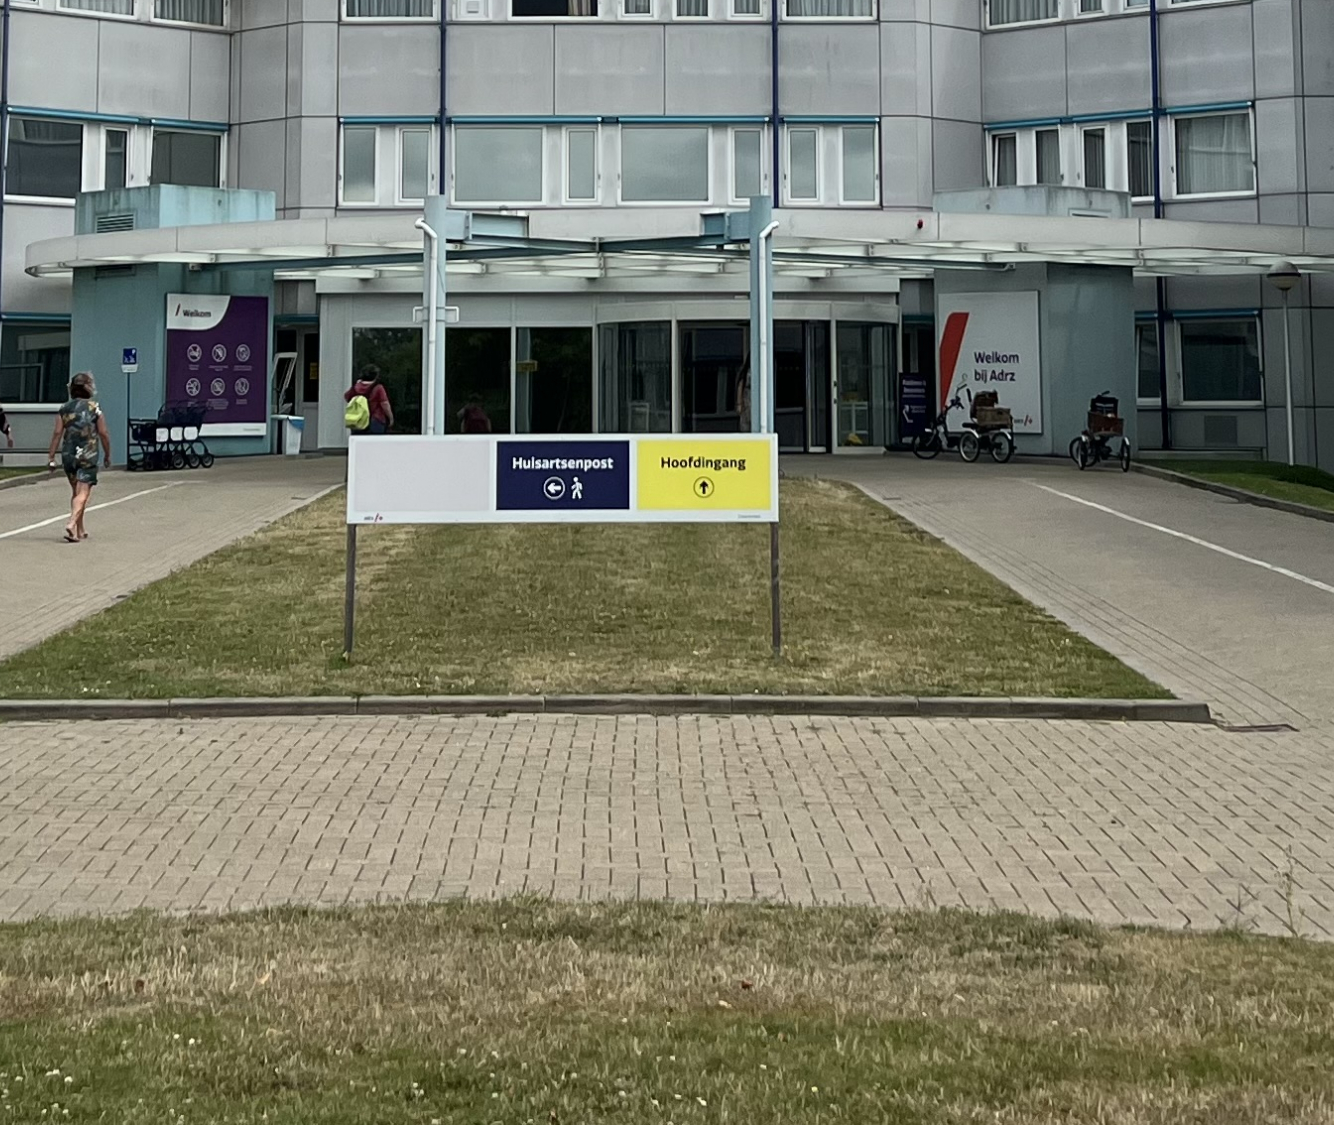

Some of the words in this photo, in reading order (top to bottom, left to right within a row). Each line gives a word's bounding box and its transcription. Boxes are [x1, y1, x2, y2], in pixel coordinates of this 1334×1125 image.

[183, 309, 212, 318] Welkom
[974, 350, 1020, 364] Welkom
[974, 368, 988, 384] bij
[989, 368, 1016, 382] Adrz
[512, 456, 614, 472] Huisartsenpost
[660, 456, 747, 471] Hoofdingang
